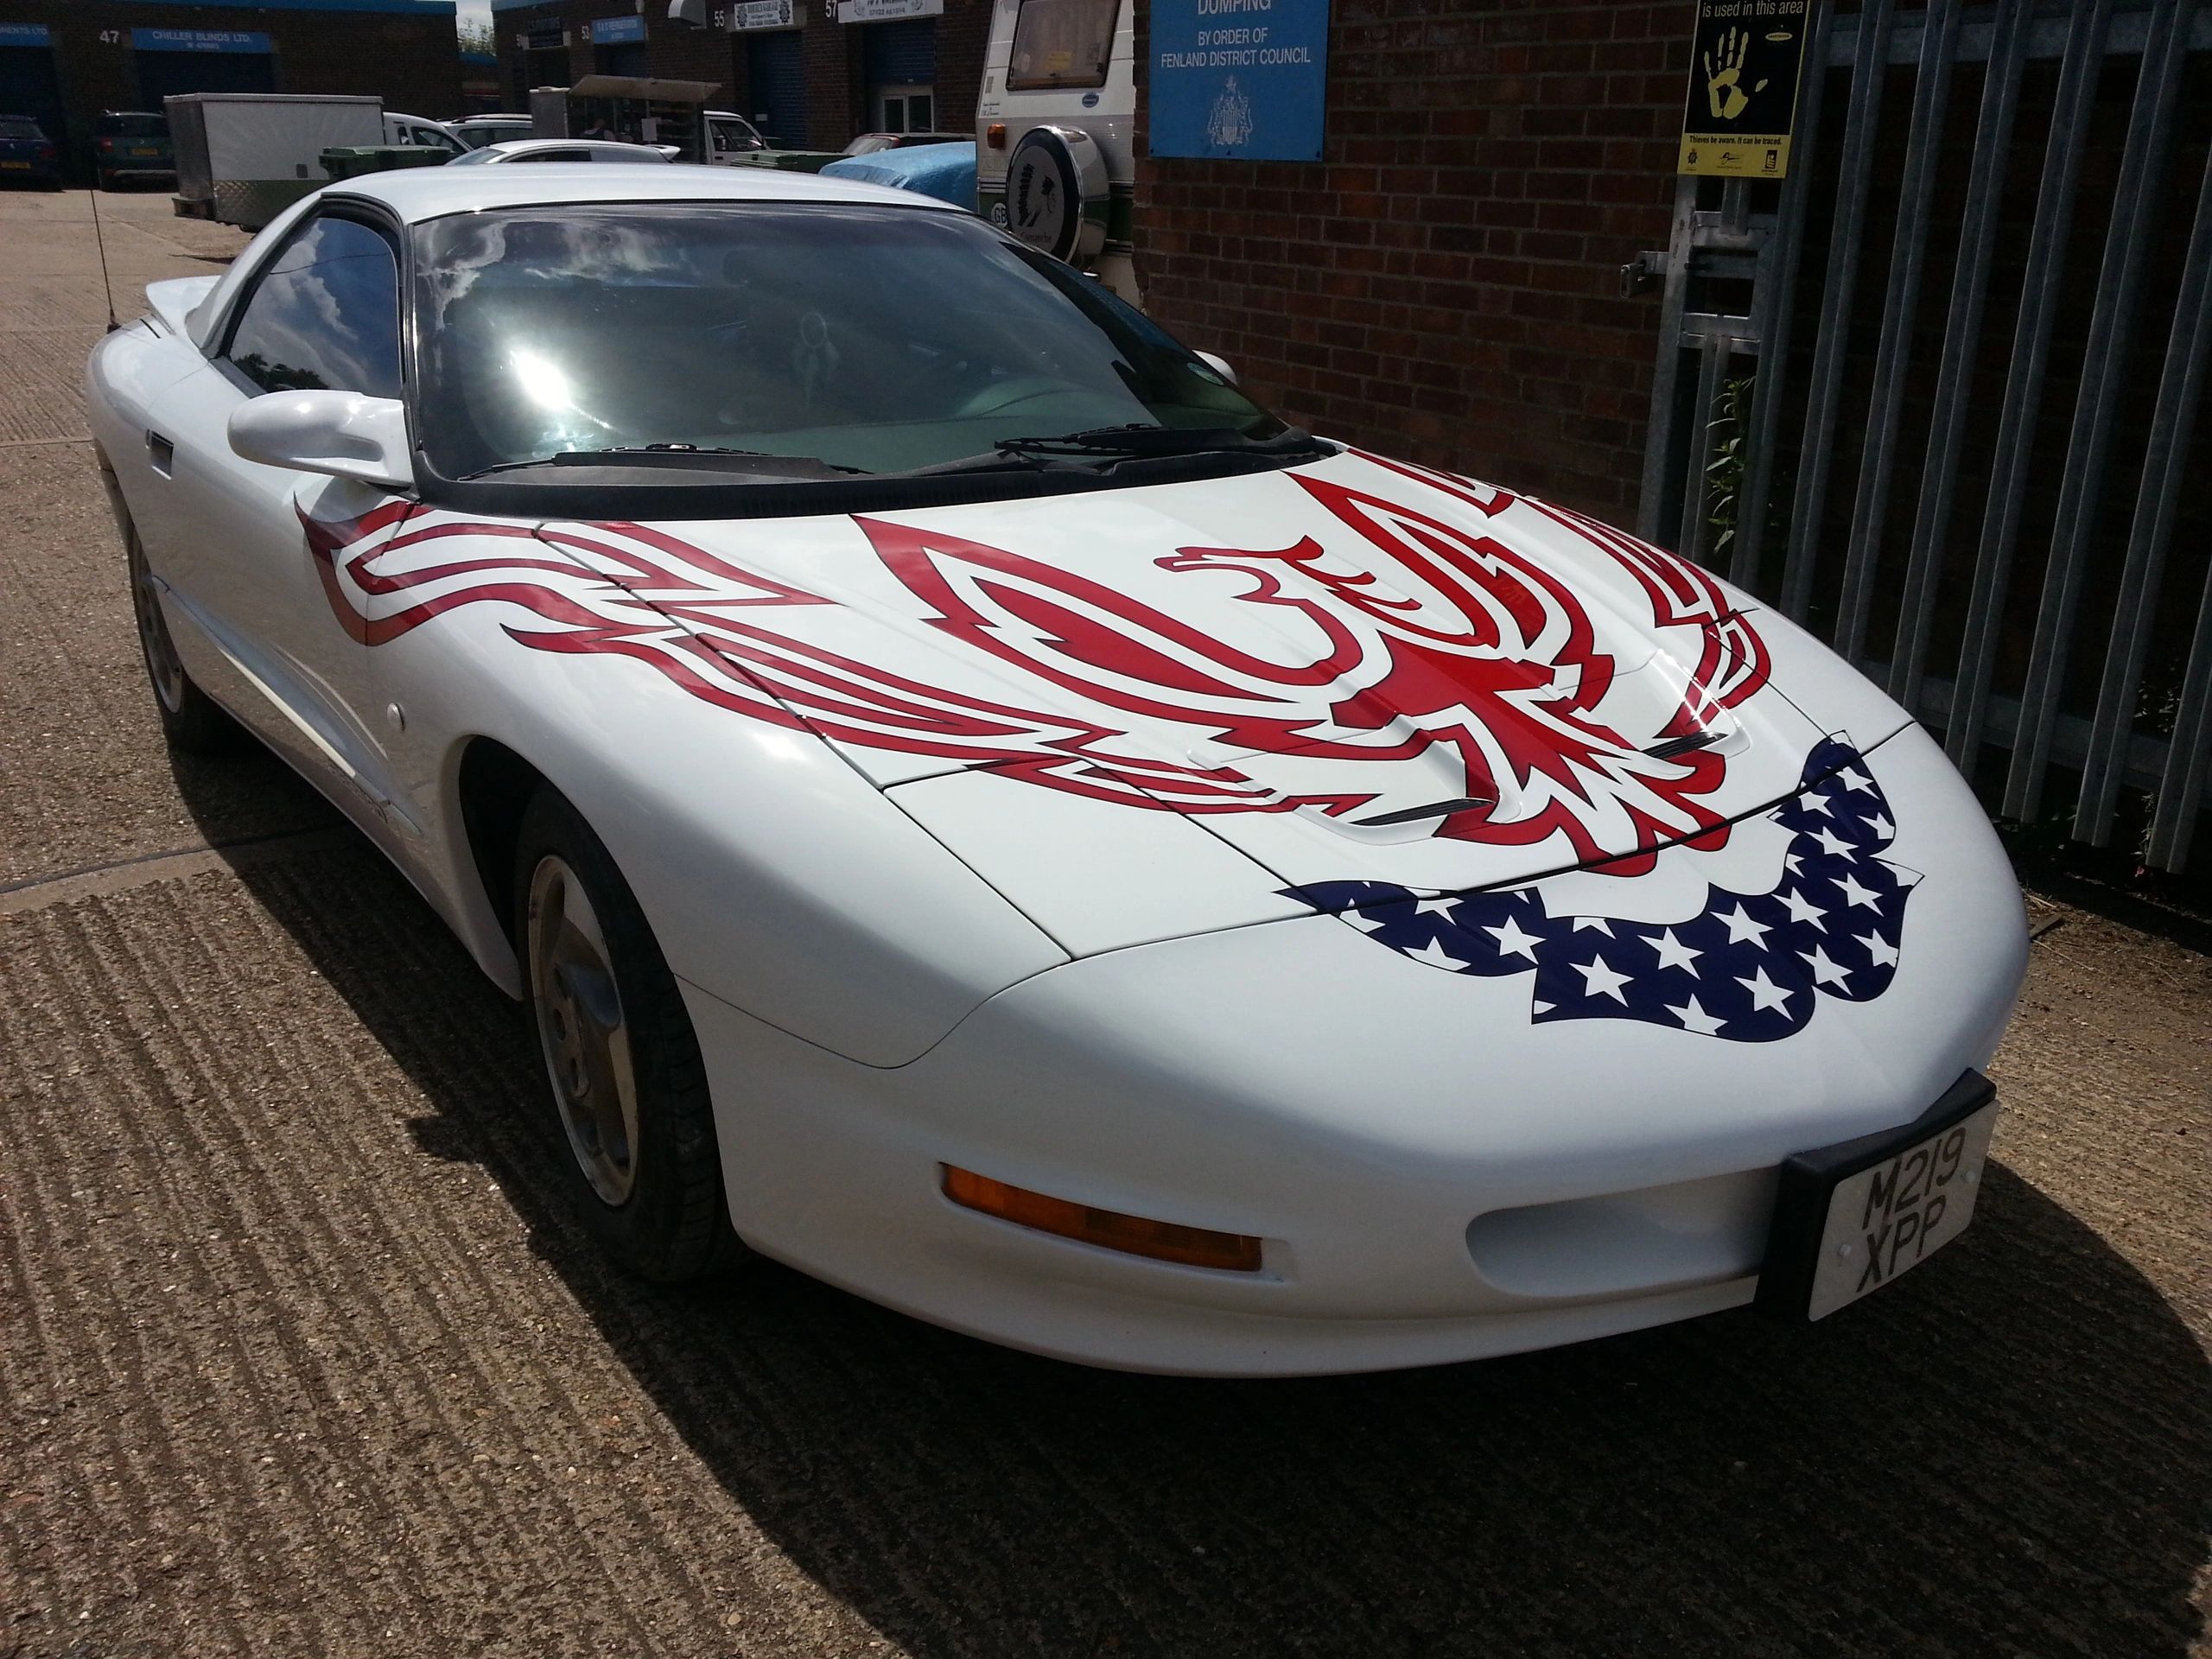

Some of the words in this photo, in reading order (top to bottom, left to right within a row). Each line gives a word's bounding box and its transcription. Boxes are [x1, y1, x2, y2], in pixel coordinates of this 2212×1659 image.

[1702, 3, 1711, 17] is
[1714, 1, 1740, 17] used
[1743, 1, 1752, 16] in
[1757, 0, 1776, 16] this
[1779, 1, 1803, 14] area
[715, 10, 724, 27] 55
[99, 30, 119, 43] 47
[152, 30, 193, 41] CHILLER
[196, 32, 230, 42] BLINDS
[1198, 31, 1211, 46] BY
[1213, 29, 1249, 45] ORDER
[1253, 28, 1268, 43] OF
[1161, 53, 1207, 68] FENLAND
[1210, 49, 1257, 67] DISTRICT
[1259, 47, 1311, 65] COUNCIL
[995, 207, 1007, 223] GB
[1862, 1127, 1966, 1230] M219
[1856, 1195, 1947, 1293] XPP
